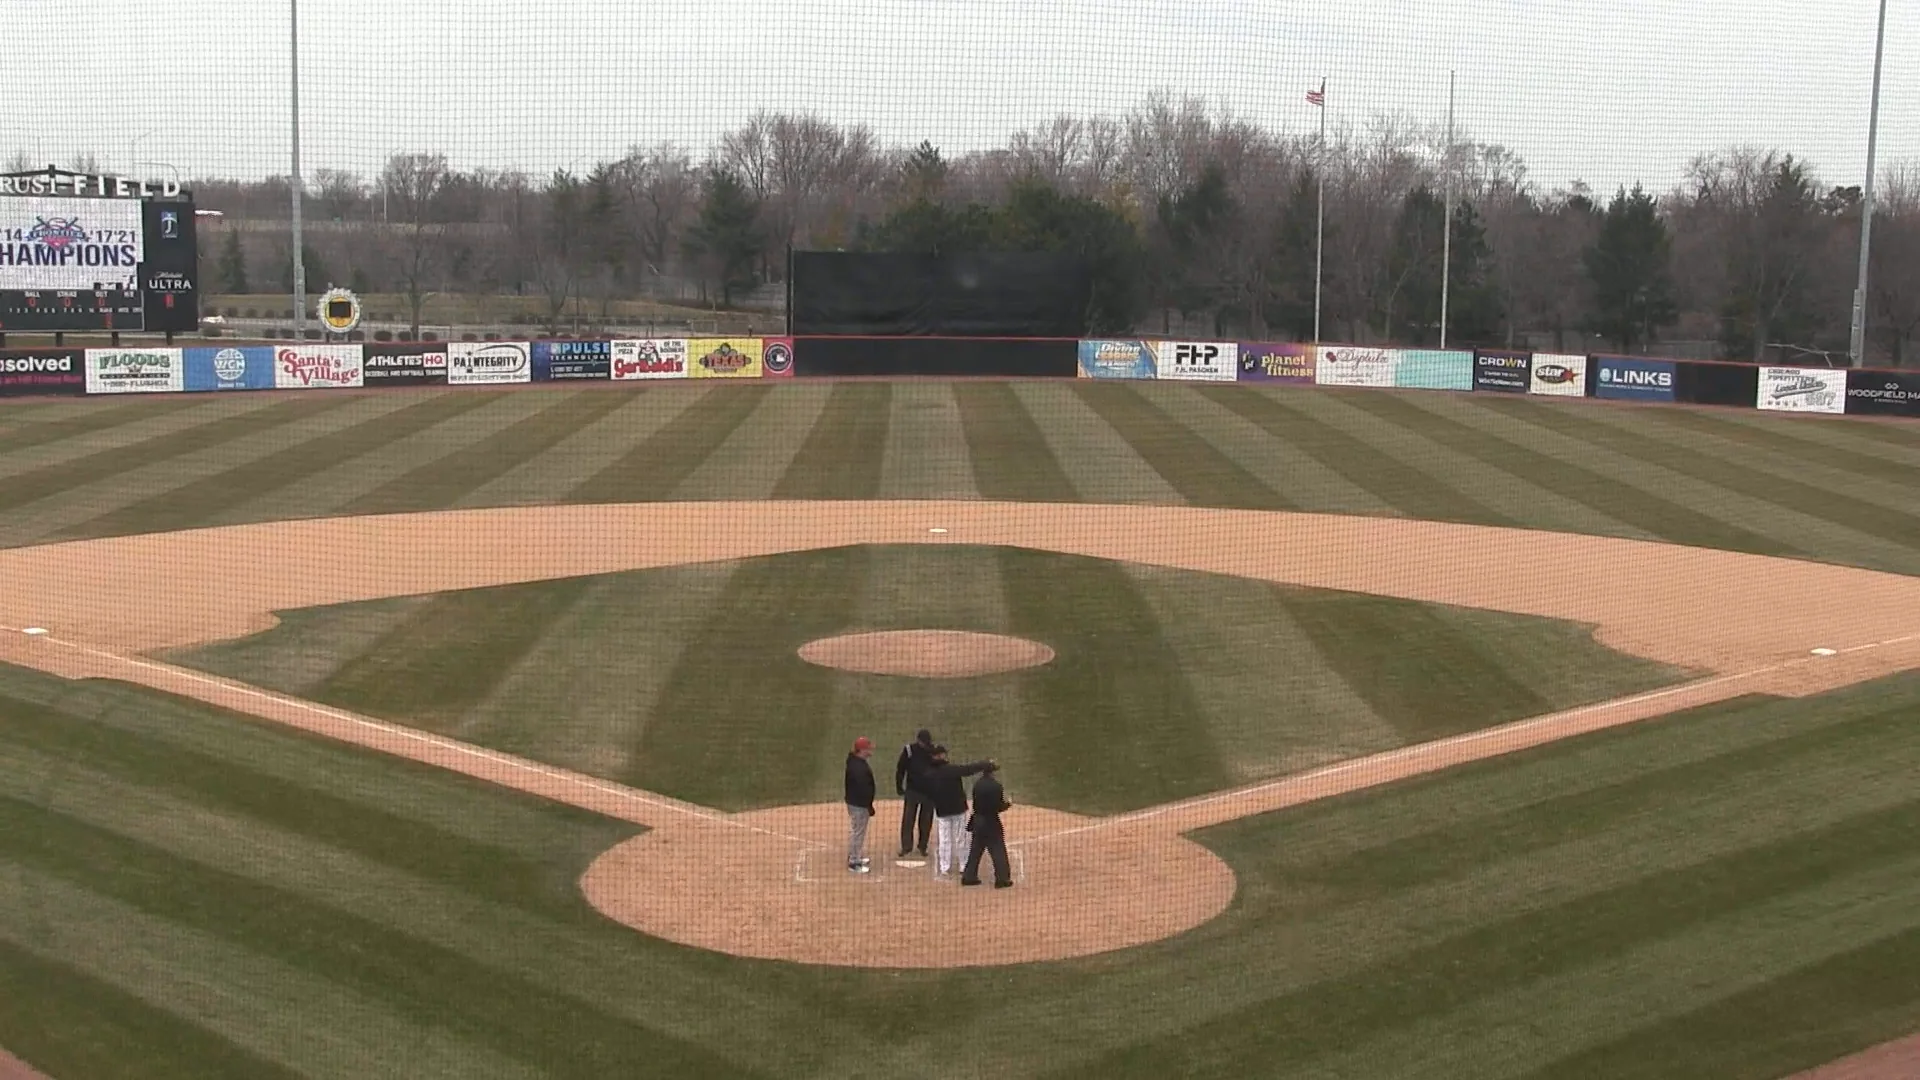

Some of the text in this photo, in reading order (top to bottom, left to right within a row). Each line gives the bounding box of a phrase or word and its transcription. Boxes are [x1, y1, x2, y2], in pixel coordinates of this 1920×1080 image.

[74, 174, 180, 197] FIELD
[0, 243, 136, 267] HAMPIONS
[149, 279, 192, 289] ULTRA
[562, 342, 609, 354] PULSE
[100, 353, 170, 369] FLOODS
[279, 349, 341, 377] Santa's
[425, 355, 443, 365] HQ
[706, 354, 745, 368] TEXAS
[1261, 352, 1306, 367] planet
[1479, 357, 1526, 368] CROWN
[299, 366, 359, 385] Village
[1267, 365, 1314, 377] fitness
[1537, 366, 1565, 378] star
[1612, 368, 1672, 386] LINKS
[1847, 388, 1906, 399] WOODFIELD
